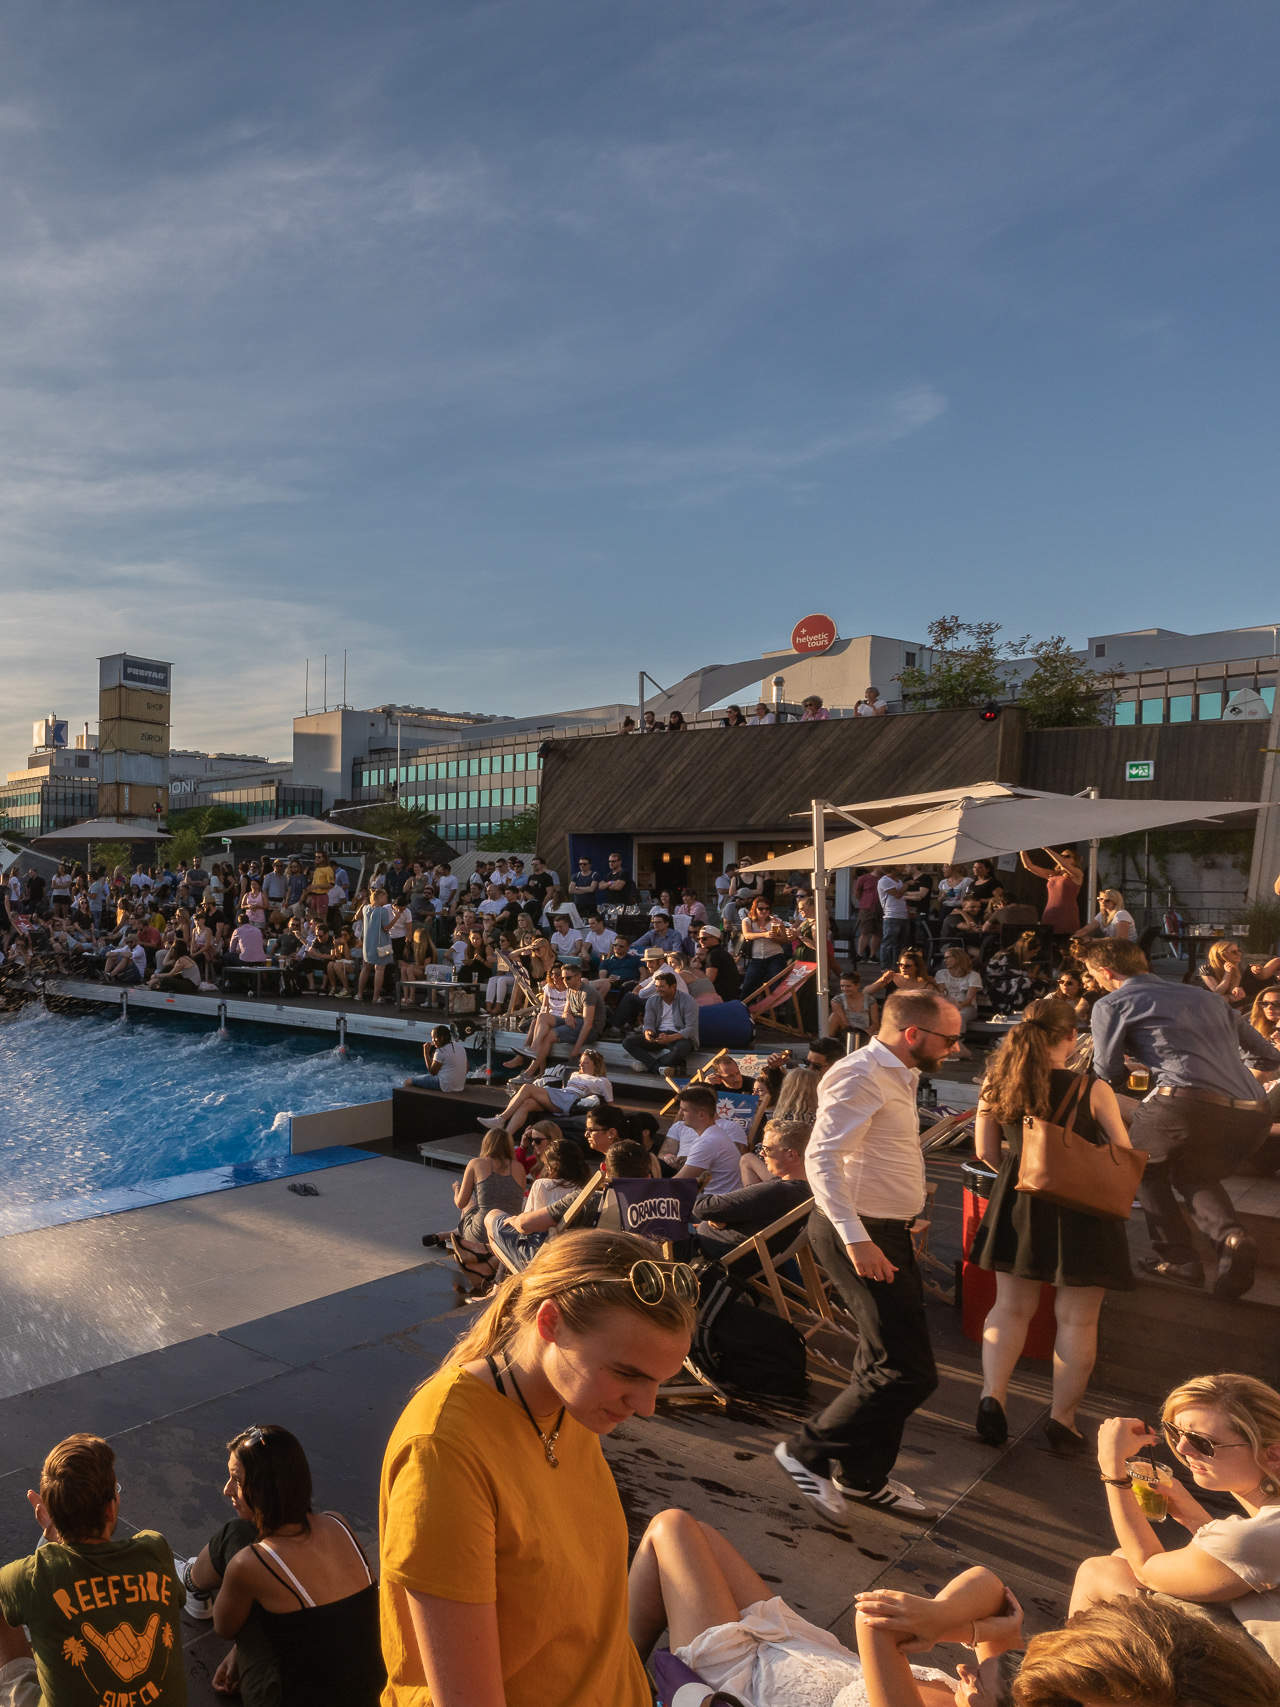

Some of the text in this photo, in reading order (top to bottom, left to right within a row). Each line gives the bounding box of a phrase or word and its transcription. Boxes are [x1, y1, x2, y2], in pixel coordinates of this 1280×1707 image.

[796, 632, 829, 643] helvetic
[807, 639, 829, 648] tours
[52, 1571, 172, 1620] REEFSIDE
